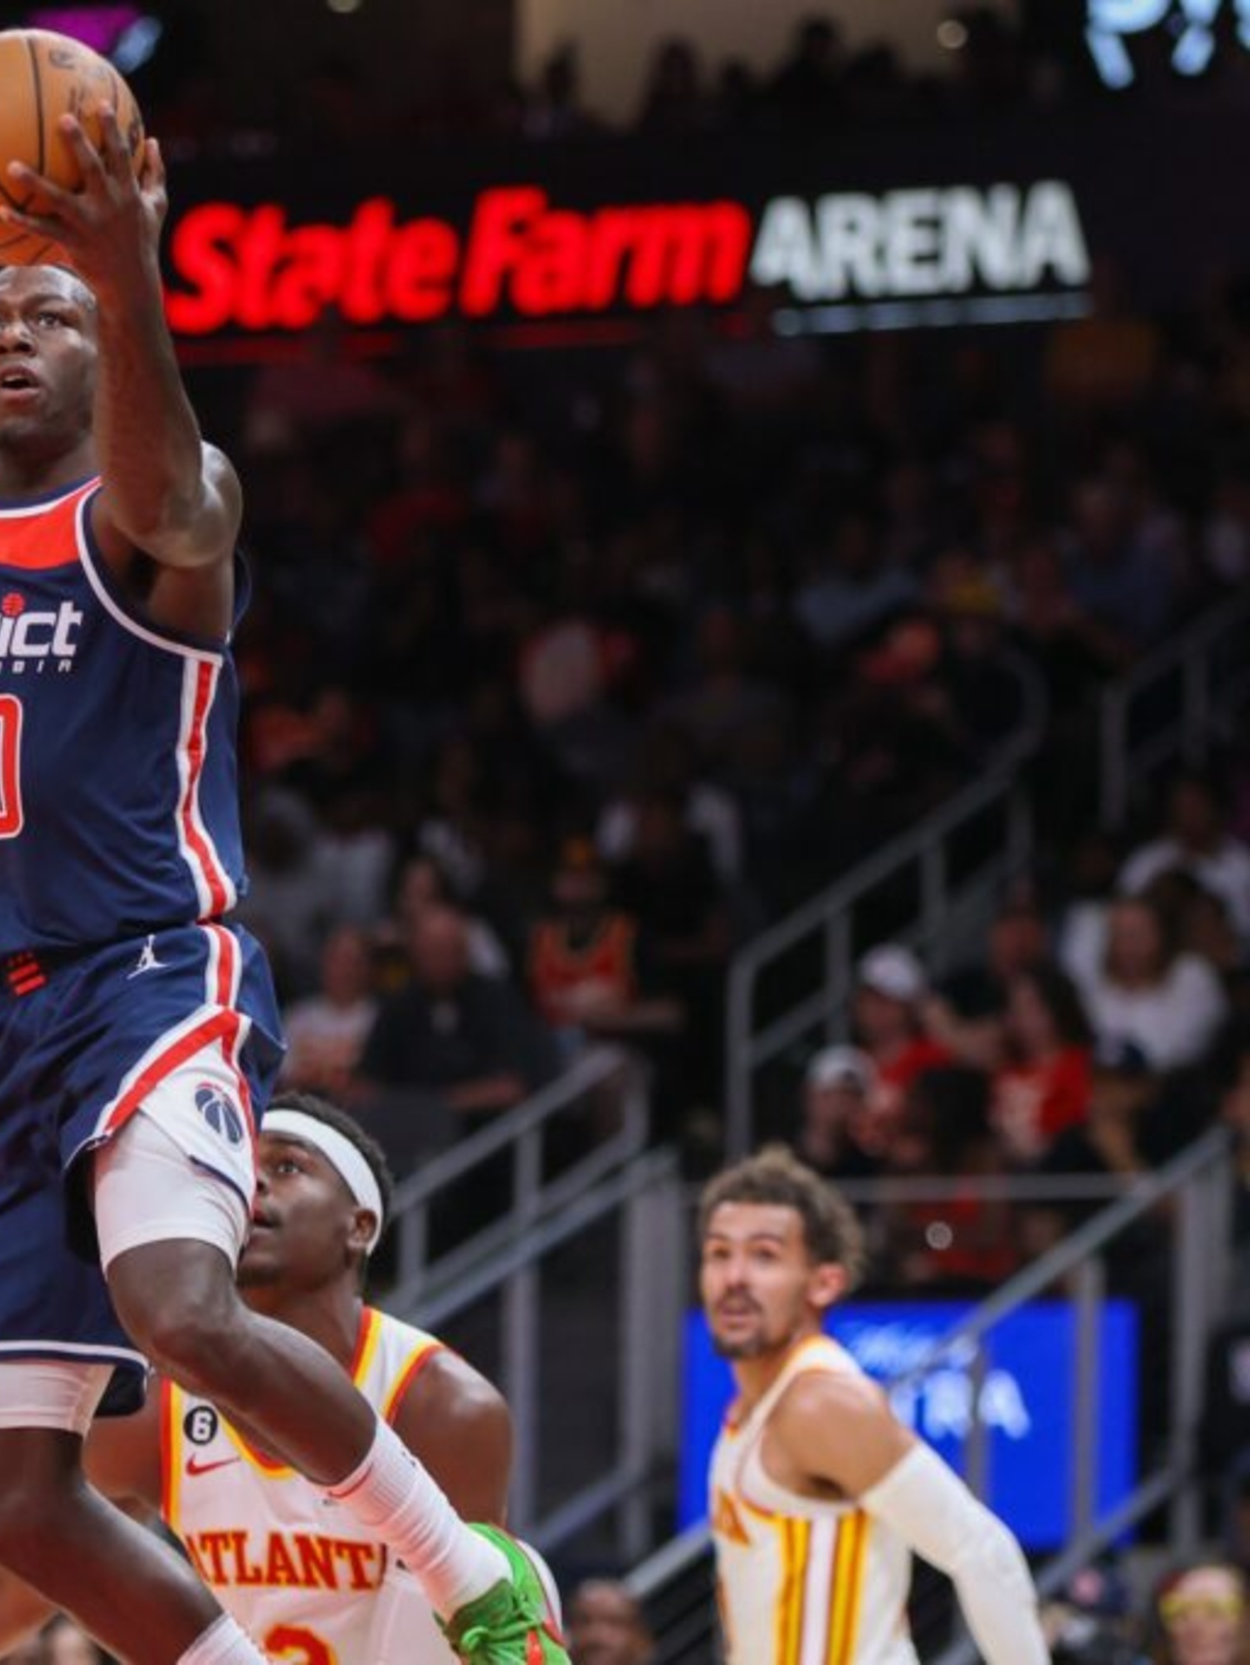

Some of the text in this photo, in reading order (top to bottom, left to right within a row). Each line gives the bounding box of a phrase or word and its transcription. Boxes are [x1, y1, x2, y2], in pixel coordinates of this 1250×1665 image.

[161, 181, 1088, 334] State Farm ARENA
[192, 1410, 212, 1441] 6
[185, 1530, 388, 1591] TLANT
